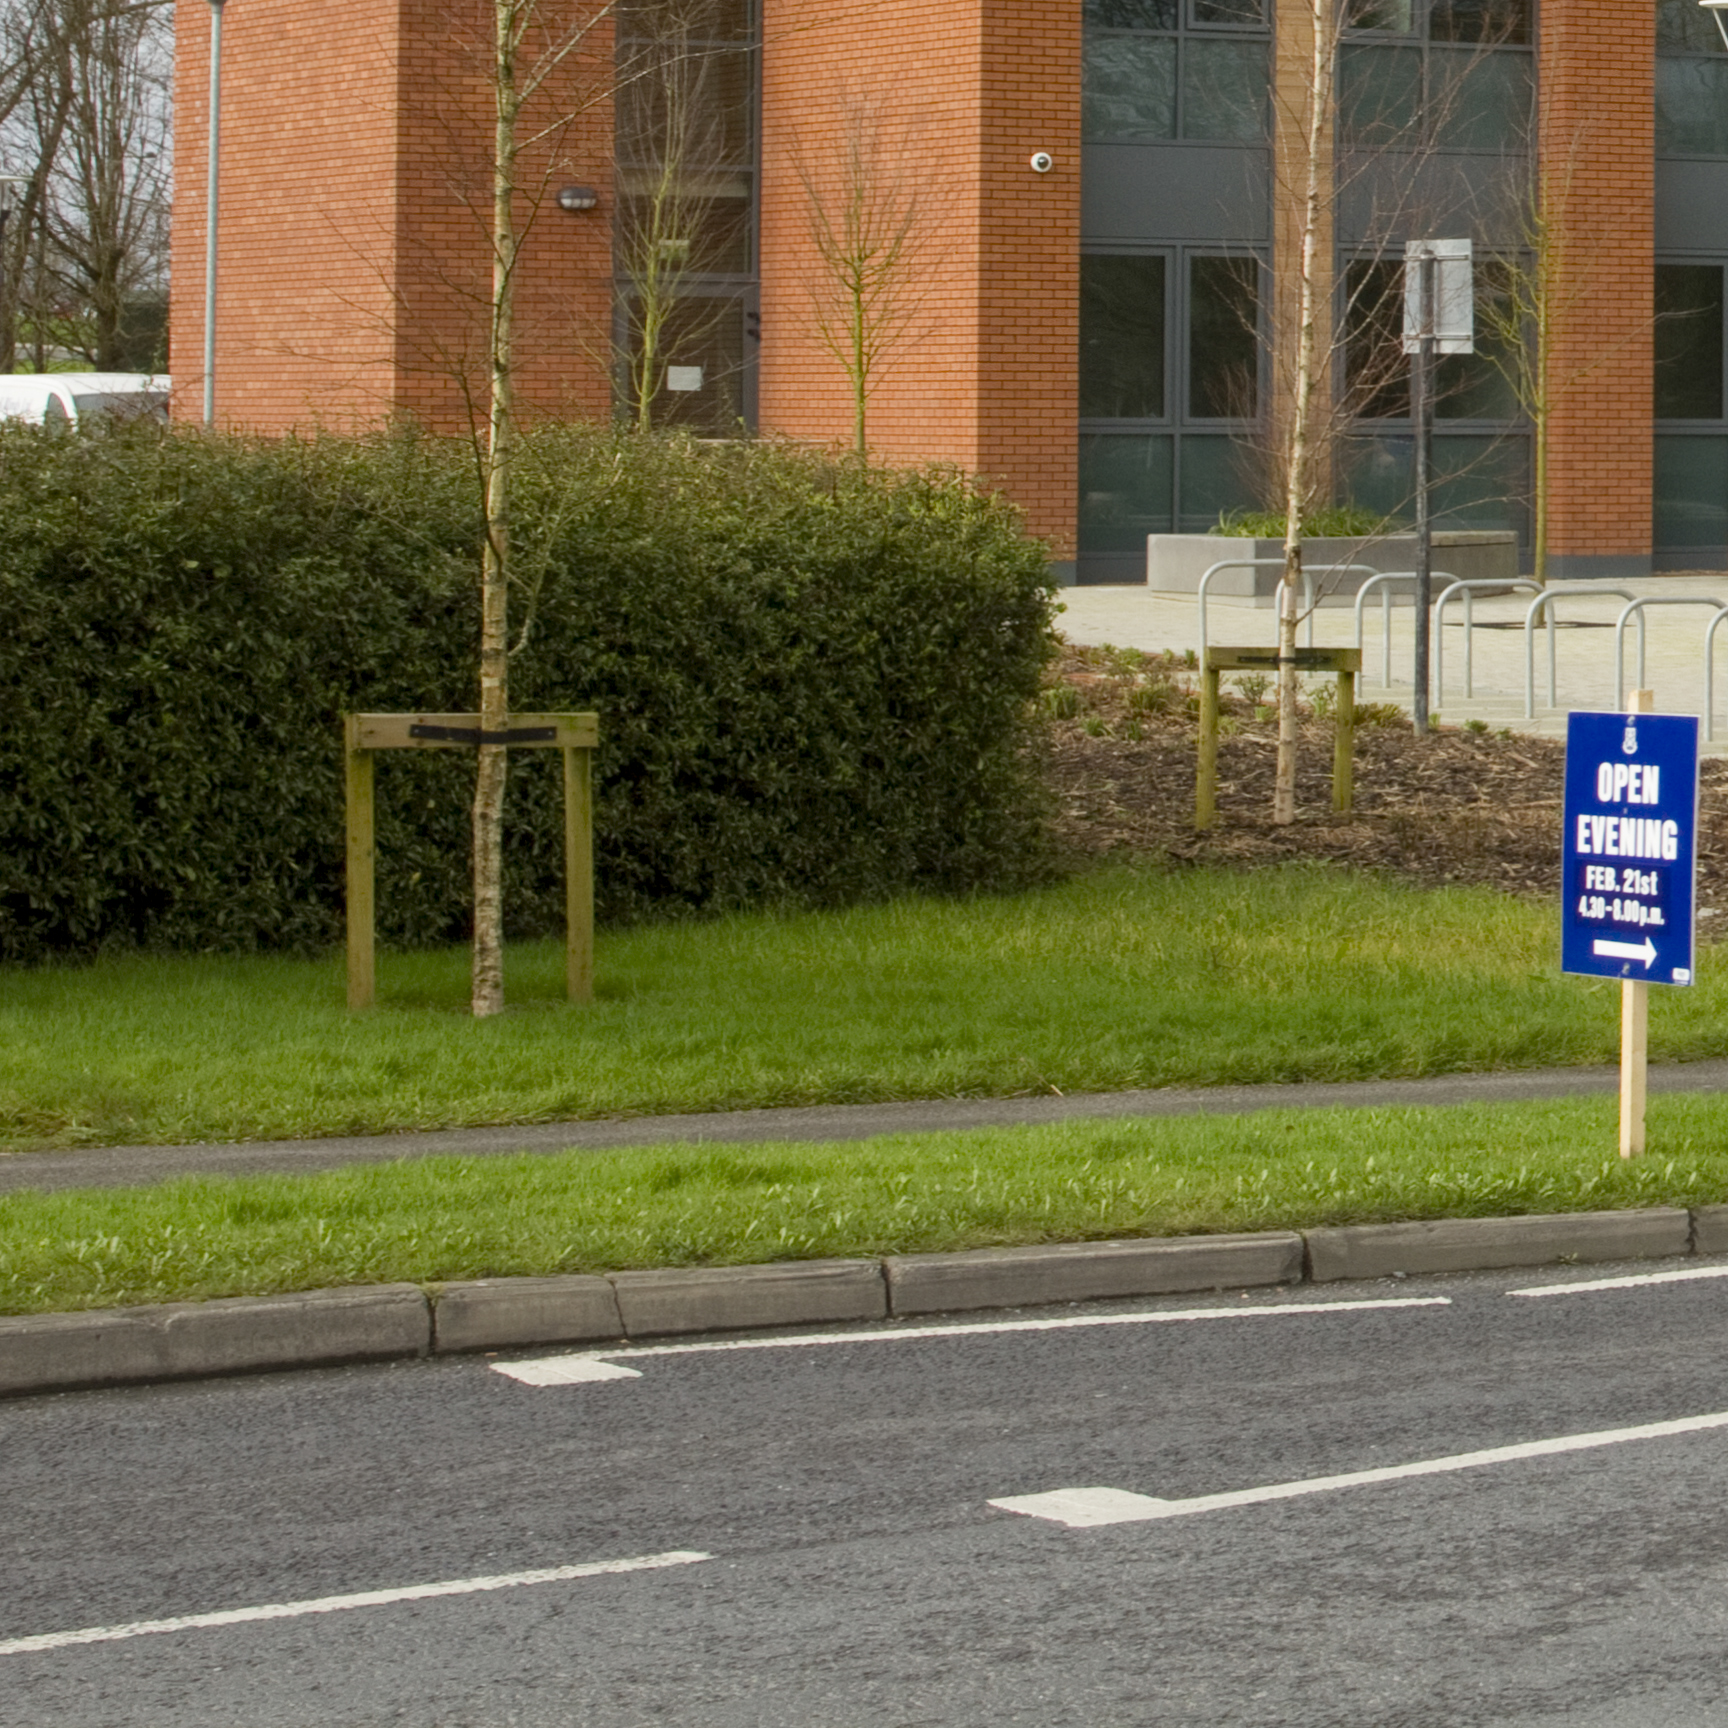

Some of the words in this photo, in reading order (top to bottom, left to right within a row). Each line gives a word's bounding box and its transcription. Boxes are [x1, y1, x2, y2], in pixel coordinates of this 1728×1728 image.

[1597, 761, 1660, 805] OPEN
[1576, 814, 1678, 860] EVENING
[1585, 865, 1621, 892] FEB.
[1622, 868, 1659, 896] 21st
